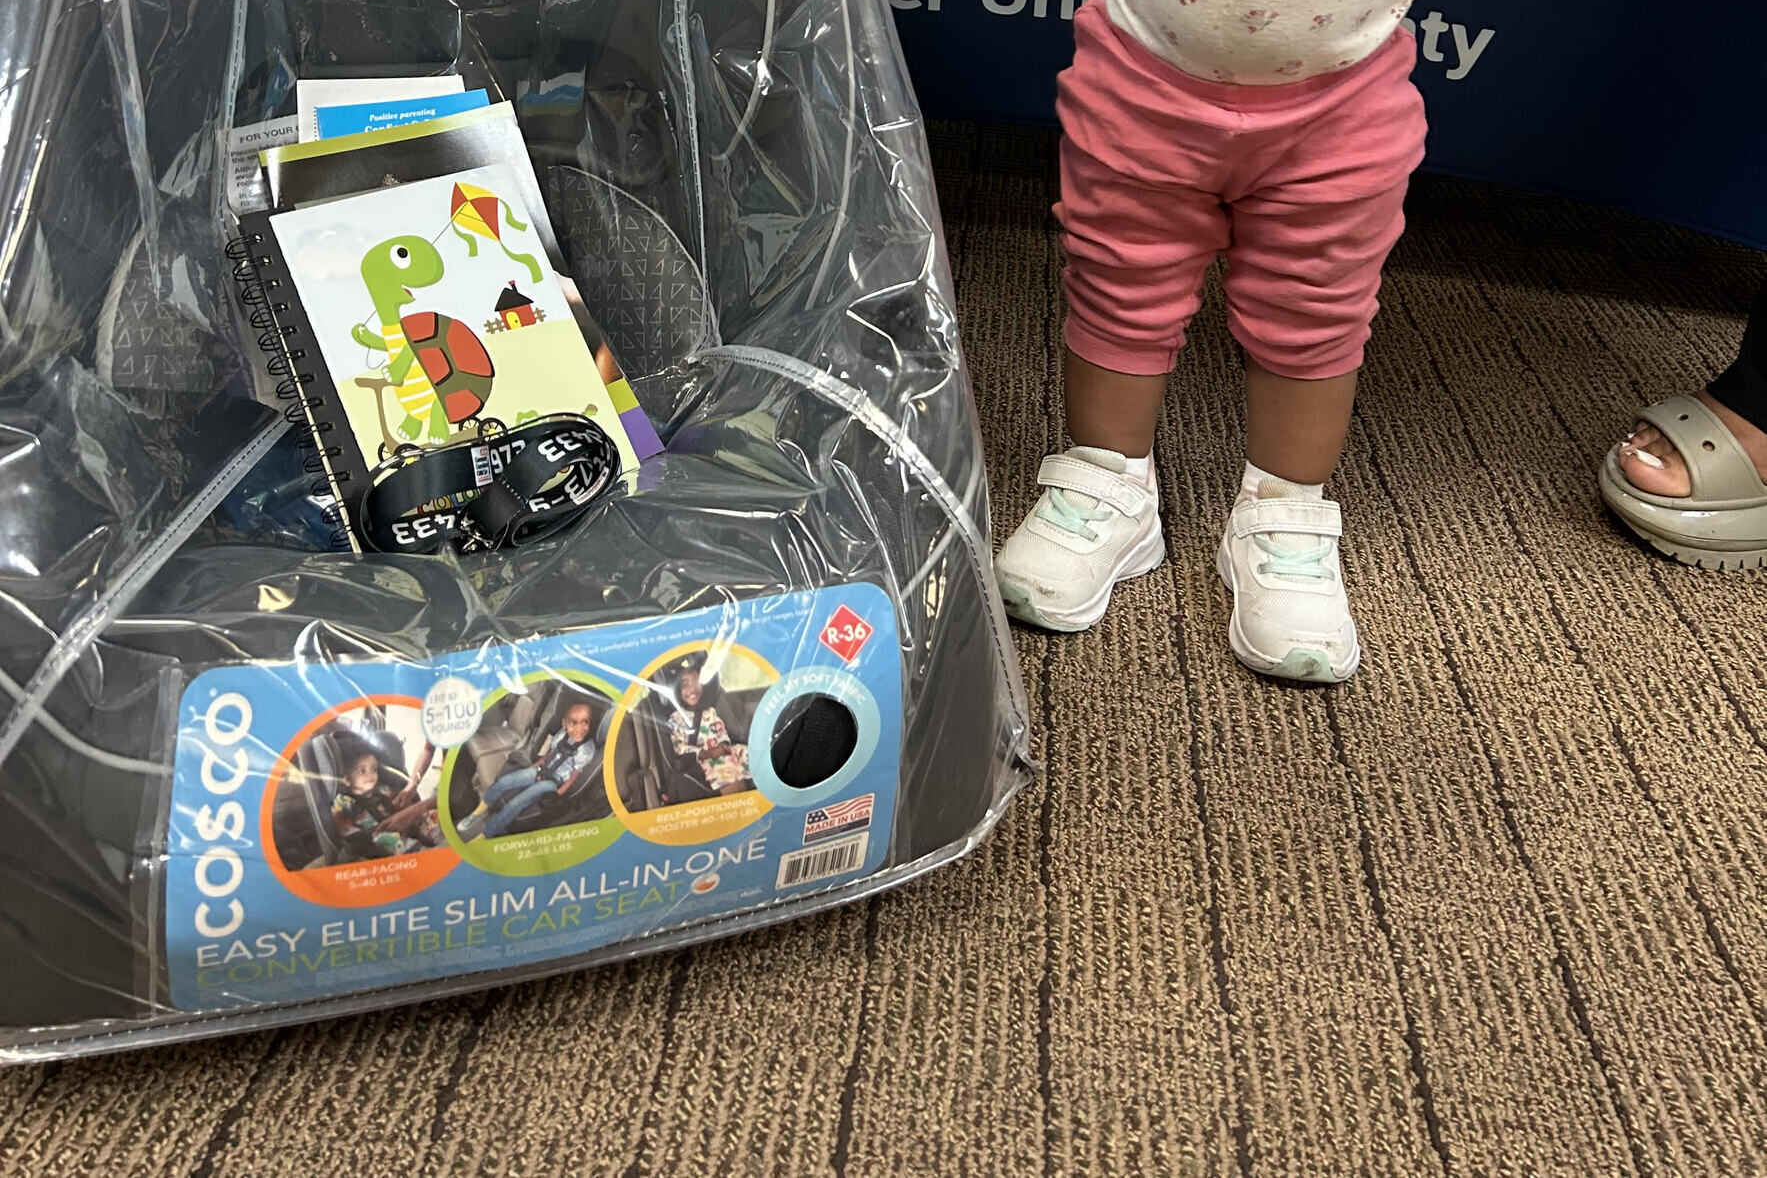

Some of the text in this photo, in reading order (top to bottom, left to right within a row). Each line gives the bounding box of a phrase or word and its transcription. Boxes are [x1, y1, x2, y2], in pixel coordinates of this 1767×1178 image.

[1400, 11, 1495, 80] ty
[369, 108, 437, 123] Positive parenting
[240, 126, 293, 144] FOR YOUR
[827, 623, 866, 644] R-36
[802, 673, 831, 683] SOFT
[656, 797, 755, 823] BELT-POSITIONING
[805, 808, 872, 834] MADE IN USA
[493, 825, 600, 854] FORWARD-FACING
[647, 818, 699, 836] BOOSTER
[335, 858, 418, 882] REAR-FACING
[196, 927, 306, 968] EASY
[321, 906, 431, 947] ELITE
[444, 886, 536, 926] SLIM
[549, 837, 768, 906] ALL-IN-ONE
[196, 920, 488, 987] CONVERTIBLE
[502, 903, 582, 940] CAR
[594, 878, 685, 921] SEAT
